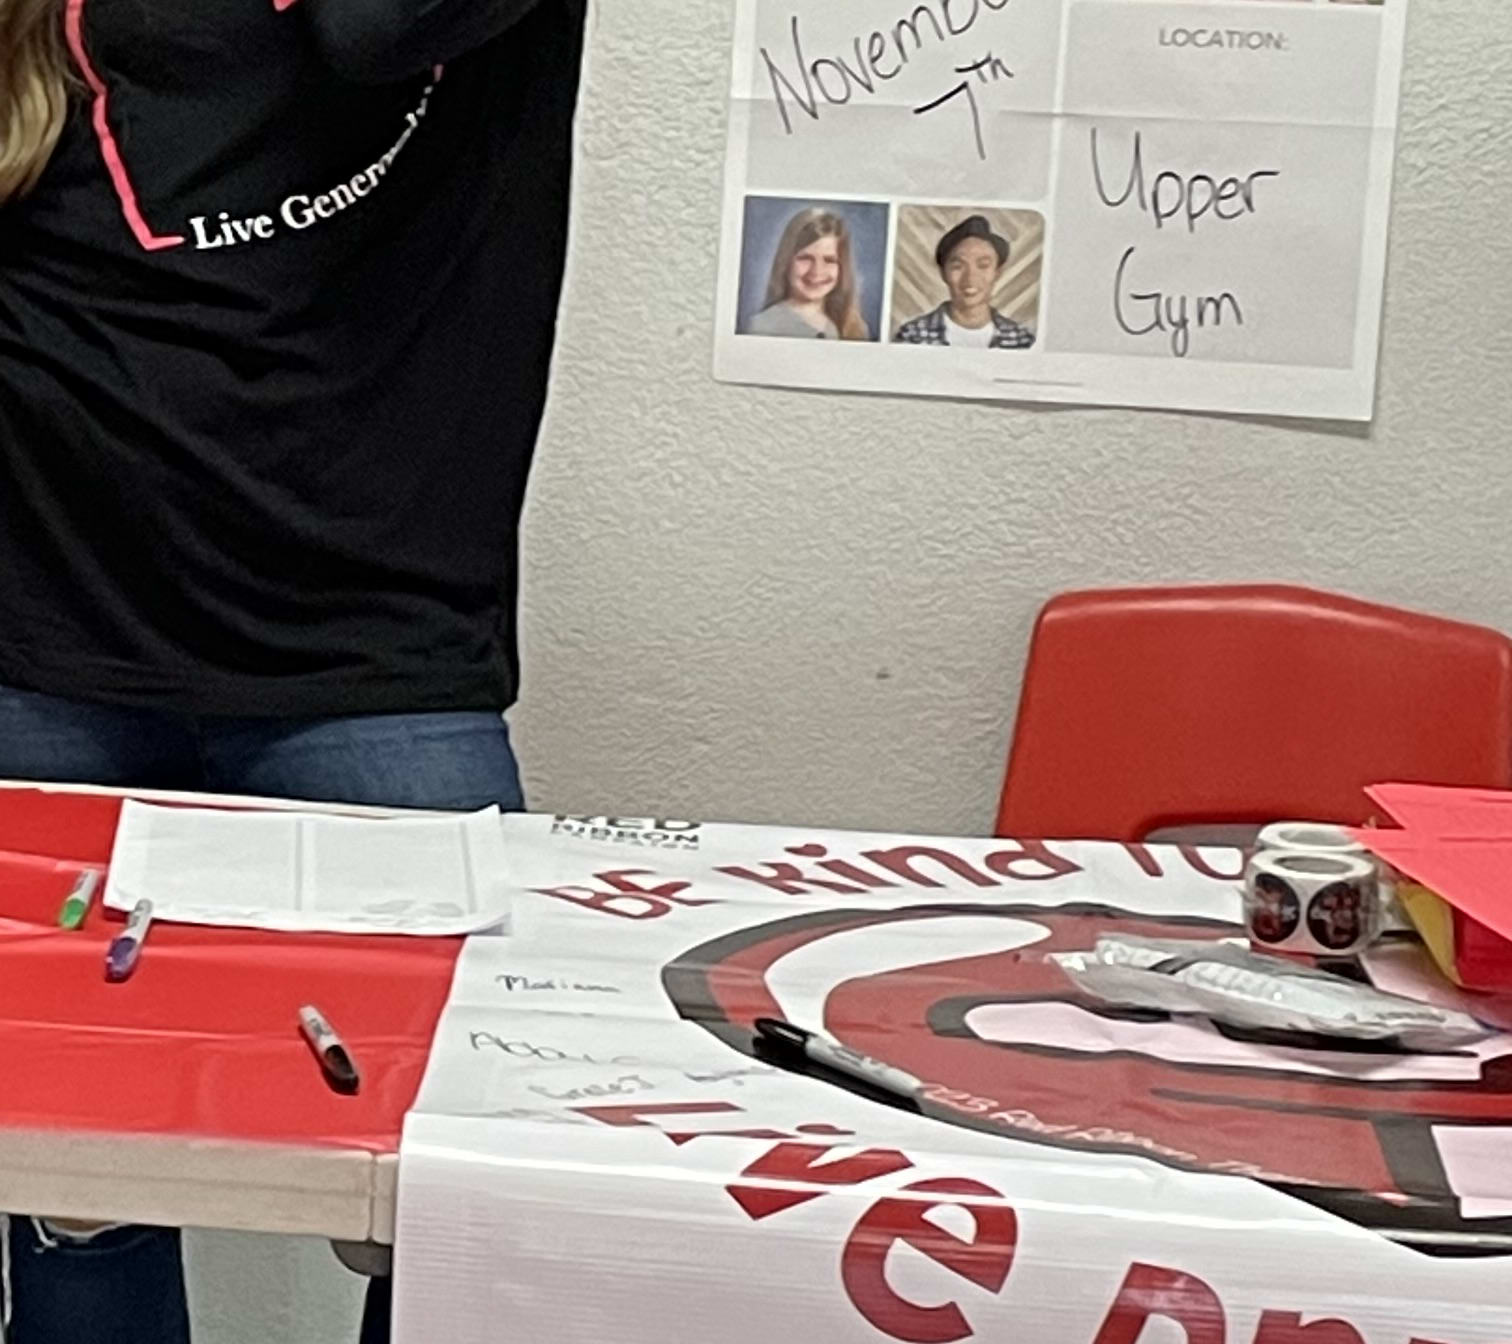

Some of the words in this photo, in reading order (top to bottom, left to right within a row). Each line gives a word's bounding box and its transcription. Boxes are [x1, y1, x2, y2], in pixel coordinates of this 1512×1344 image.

[189, 211, 276, 250] Live
[1090, 127, 1281, 234] Upper
[1113, 245, 1245, 358] Gym
